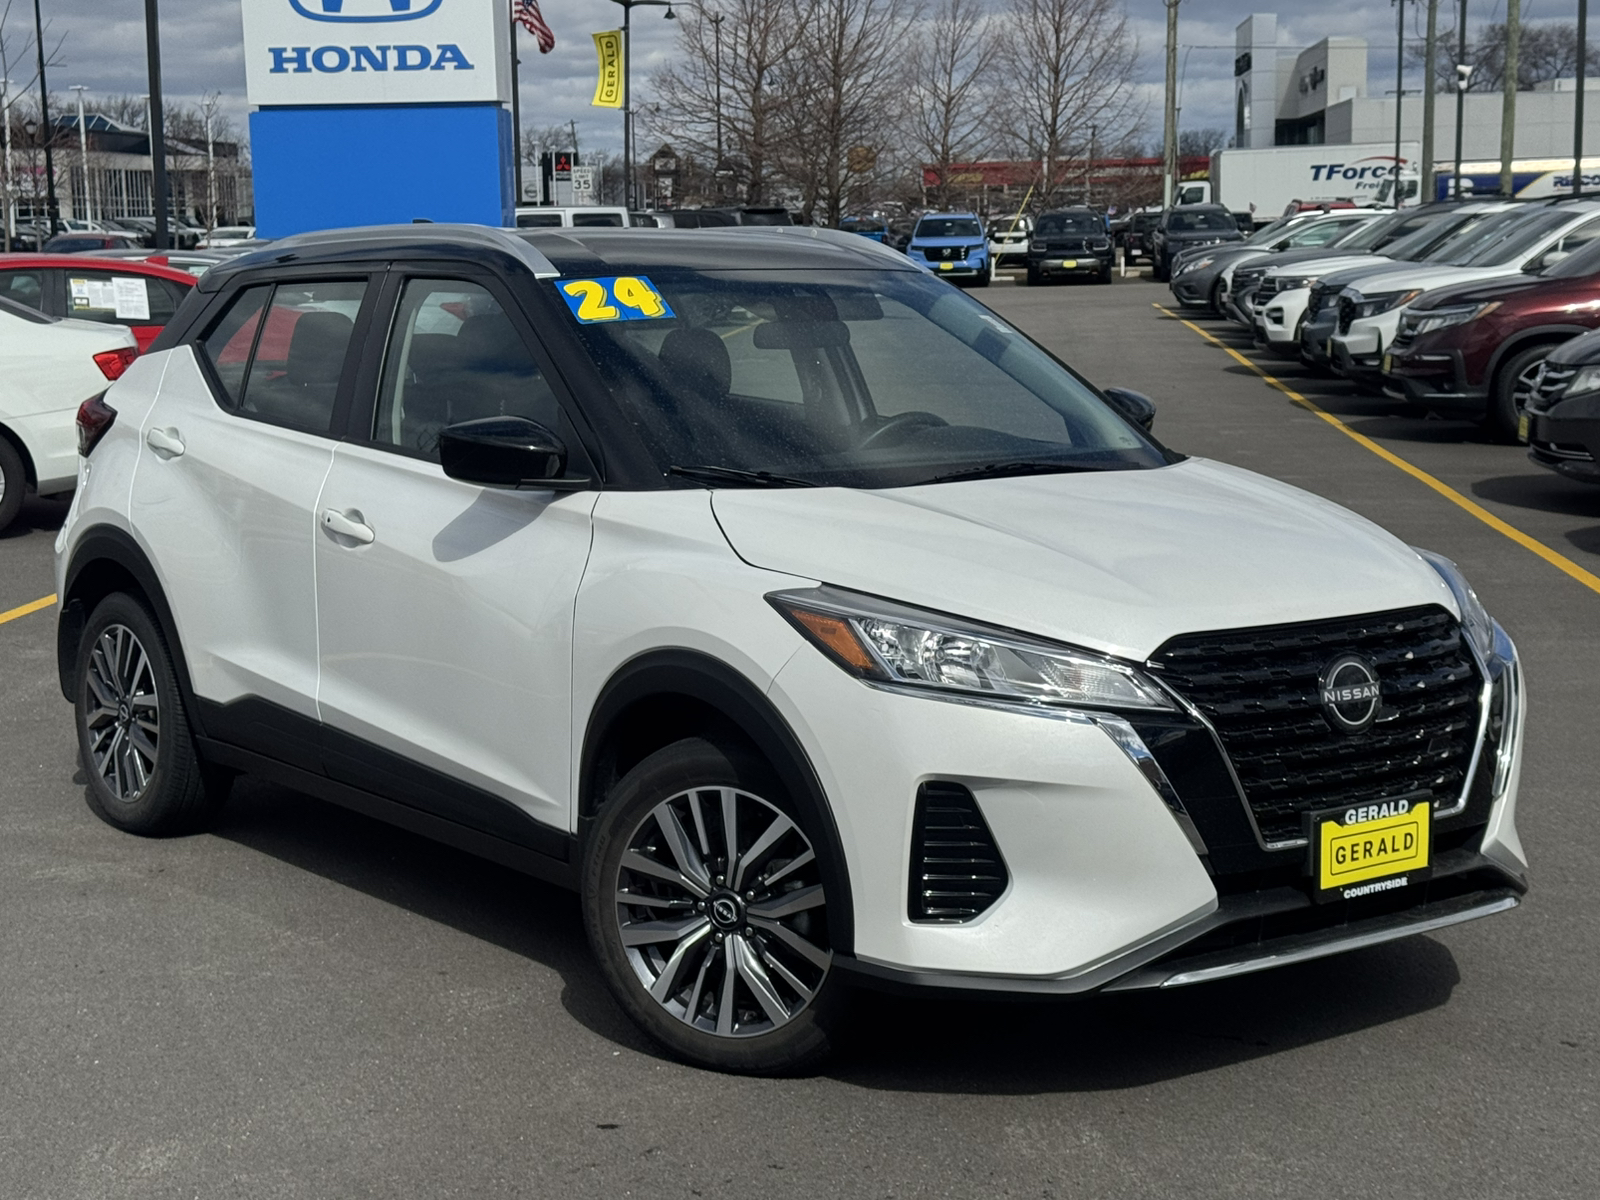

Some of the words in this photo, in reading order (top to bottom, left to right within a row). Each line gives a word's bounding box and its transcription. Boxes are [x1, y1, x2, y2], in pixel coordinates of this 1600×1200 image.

[268, 44, 475, 73] HONDA
[605, 40, 616, 97] GERALD
[574, 179, 591, 190] 35
[563, 277, 666, 321] 24
[1324, 684, 1380, 703] NISSAN
[1345, 799, 1409, 825] GERALD
[1335, 831, 1415, 865] GERALD
[1343, 876, 1408, 899] COUNTRYSIDE
